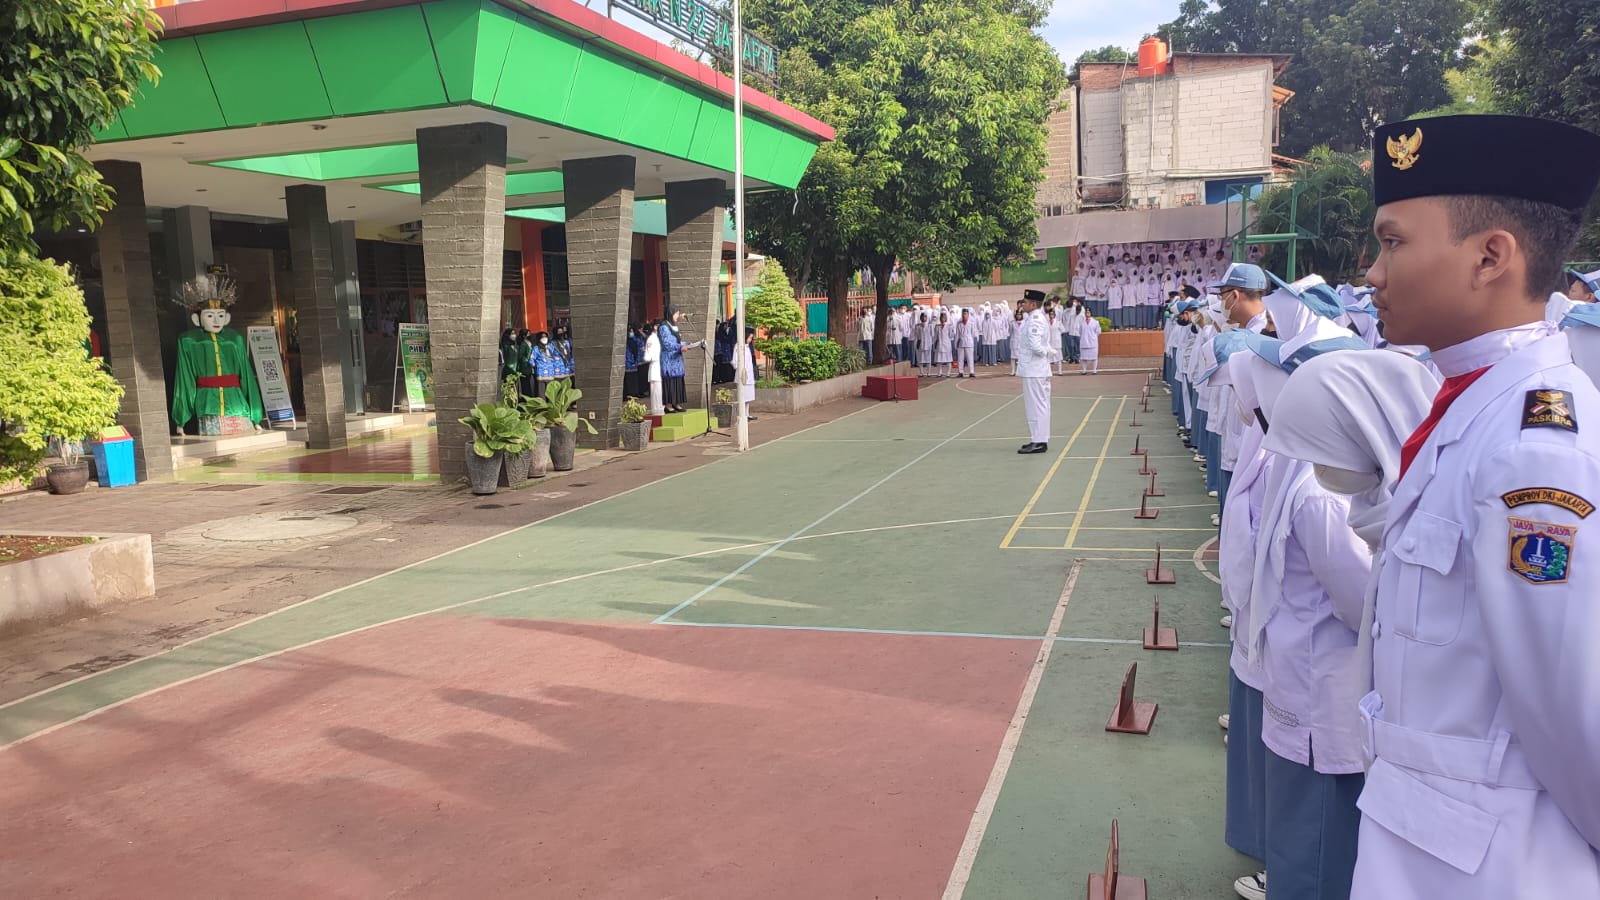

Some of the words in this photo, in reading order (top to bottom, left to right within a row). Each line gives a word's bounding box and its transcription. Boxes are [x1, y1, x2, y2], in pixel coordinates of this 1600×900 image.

[687, 0, 706, 39] 22
[713, 16, 775, 74] JAARTA
[1527, 414, 1573, 427] PASKIBRA
[1507, 490, 1540, 505] PEMPROV
[1543, 490, 1556, 500] DKI
[1556, 493, 1589, 513] JAKARTA
[1513, 521, 1535, 532] JAYA
[1547, 526, 1571, 537] RAYA
